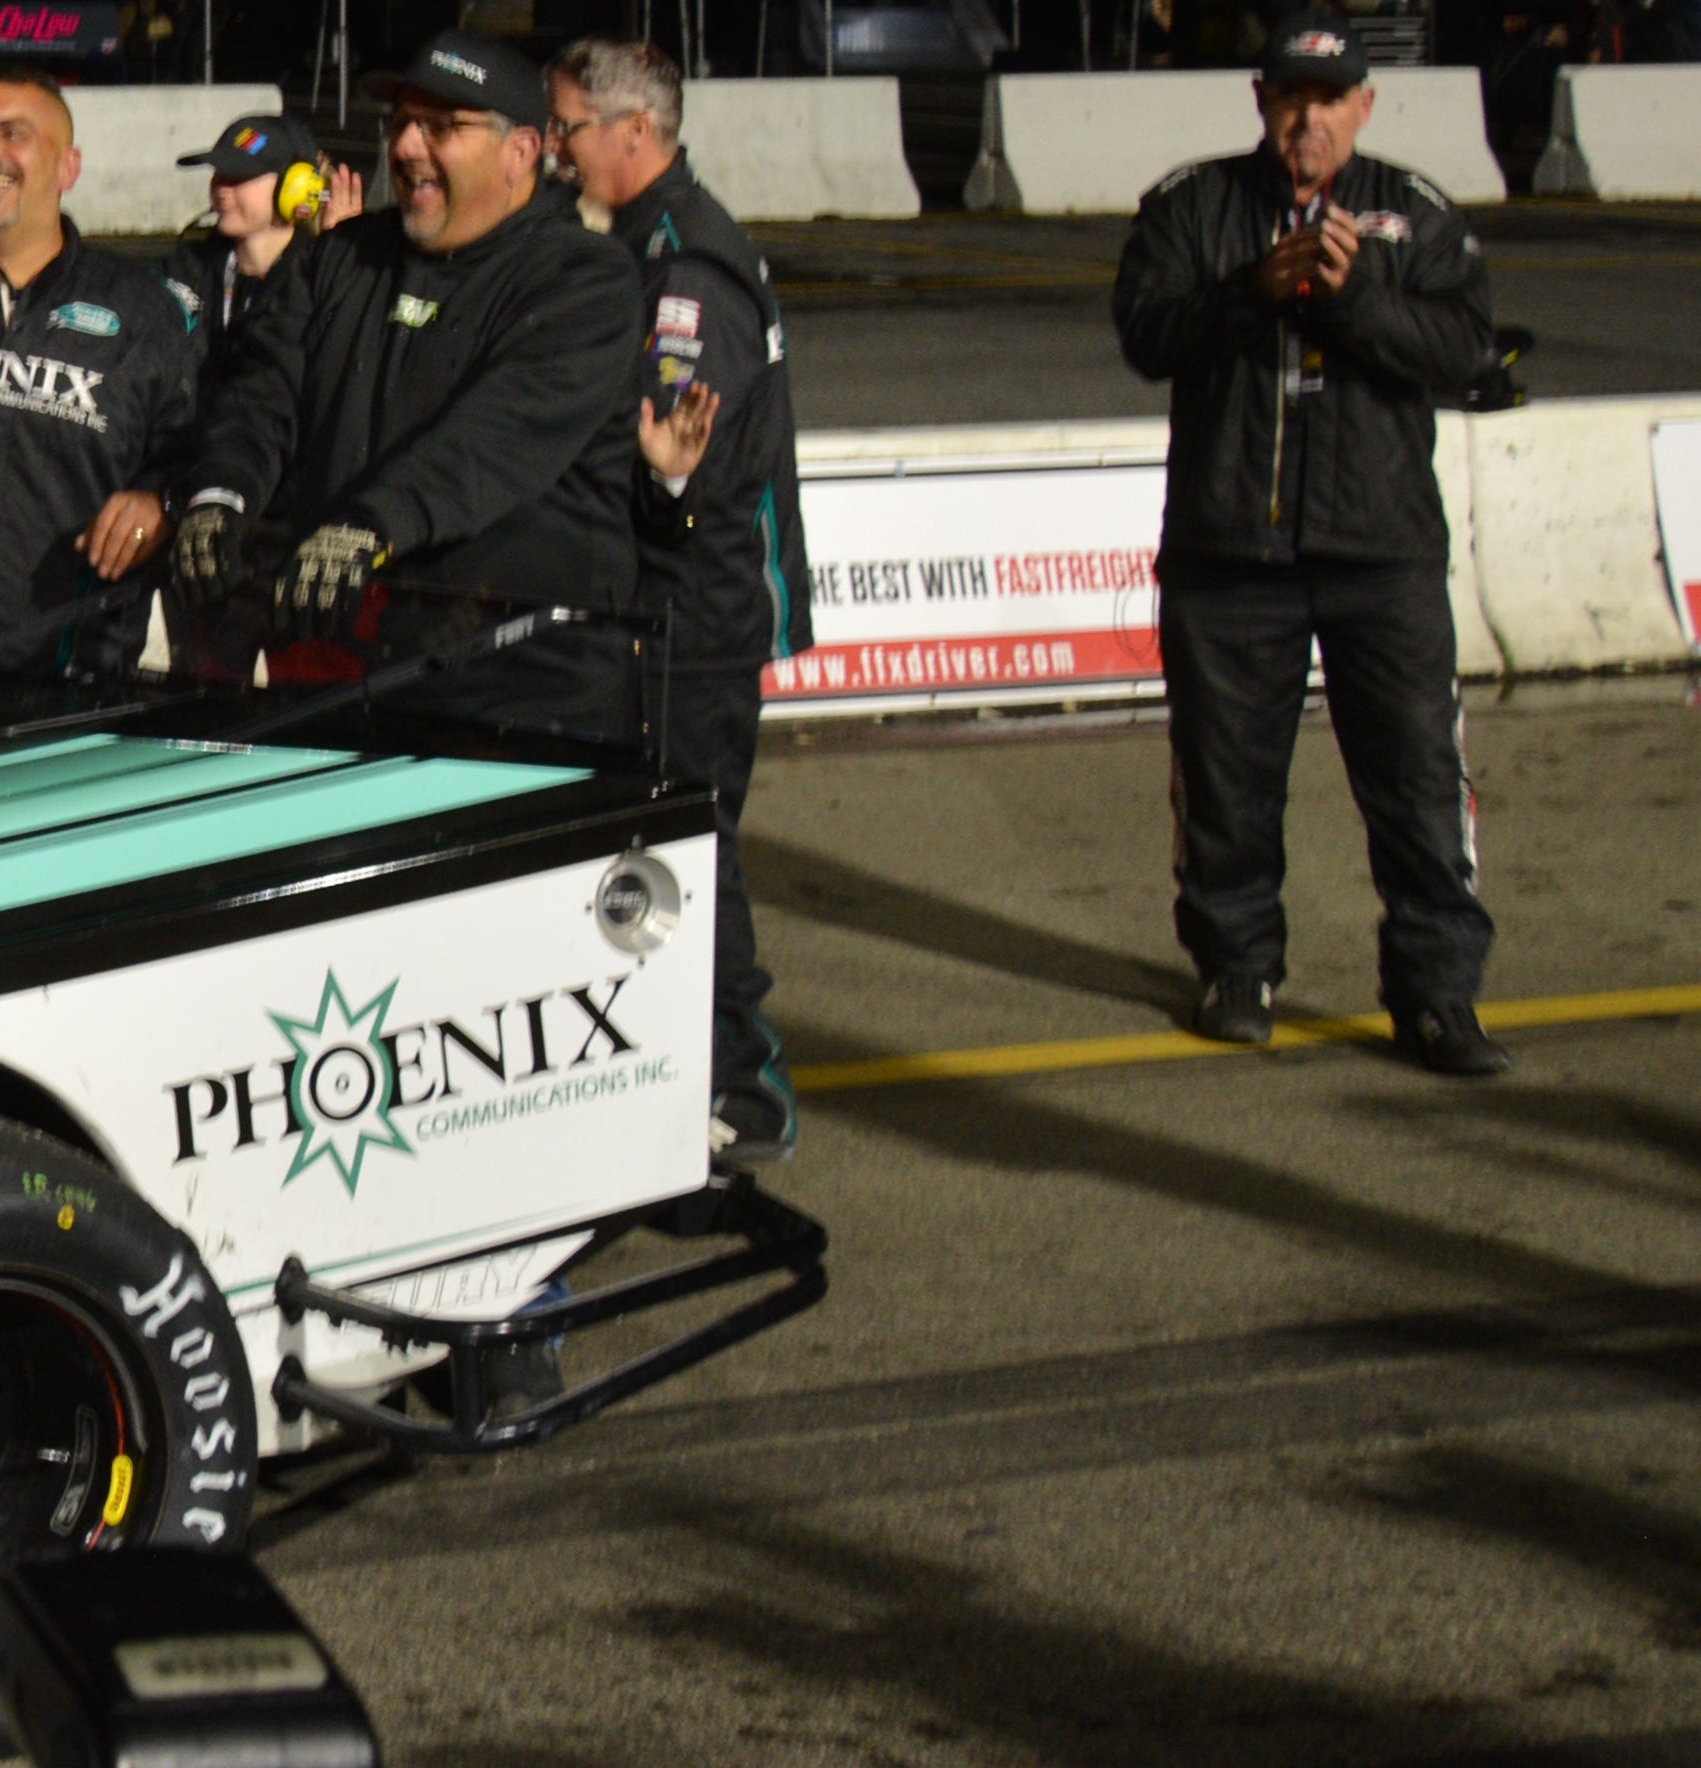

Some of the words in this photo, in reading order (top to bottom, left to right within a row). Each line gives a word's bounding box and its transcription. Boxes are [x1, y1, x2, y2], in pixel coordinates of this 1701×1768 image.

[849, 558, 913, 603] BEST
[919, 555, 990, 600] WITH
[772, 638, 1076, 693] www.ffxdriver.com
[164, 971, 642, 1166] PHOENIX
[416, 1065, 630, 1143] COMMUNICATIONS
[119, 1251, 246, 1544] Hoosie
